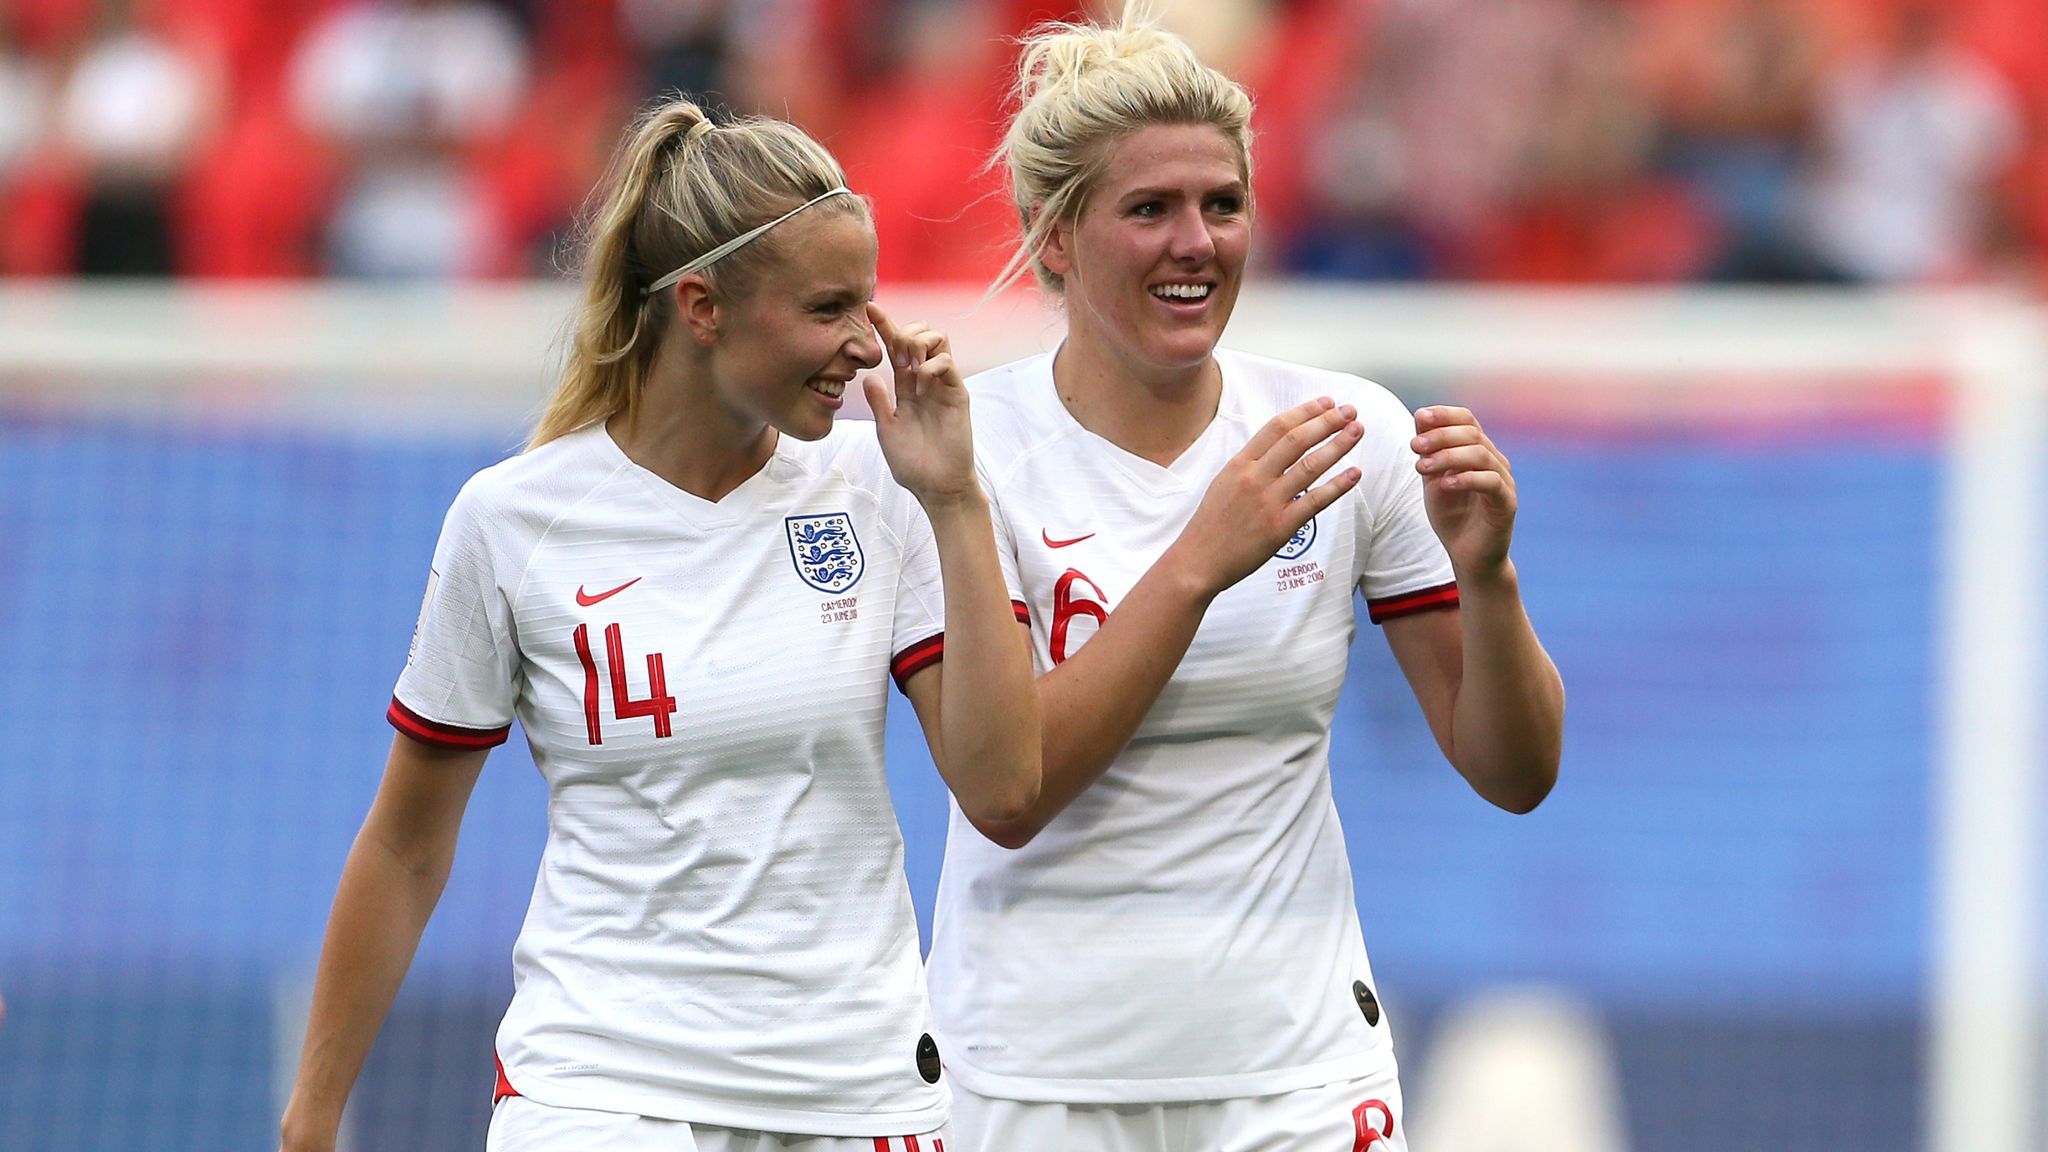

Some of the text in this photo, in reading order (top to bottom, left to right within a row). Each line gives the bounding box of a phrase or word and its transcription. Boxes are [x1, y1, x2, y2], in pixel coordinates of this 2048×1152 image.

[1277, 580, 1288, 592] 23
[1289, 577, 1306, 589] JUNE
[821, 597, 857, 612] CAMEROO
[821, 613, 832, 624] 23
[834, 610, 849, 622] JUNE
[1050, 567, 1109, 667] 6
[572, 622, 678, 745] 14
